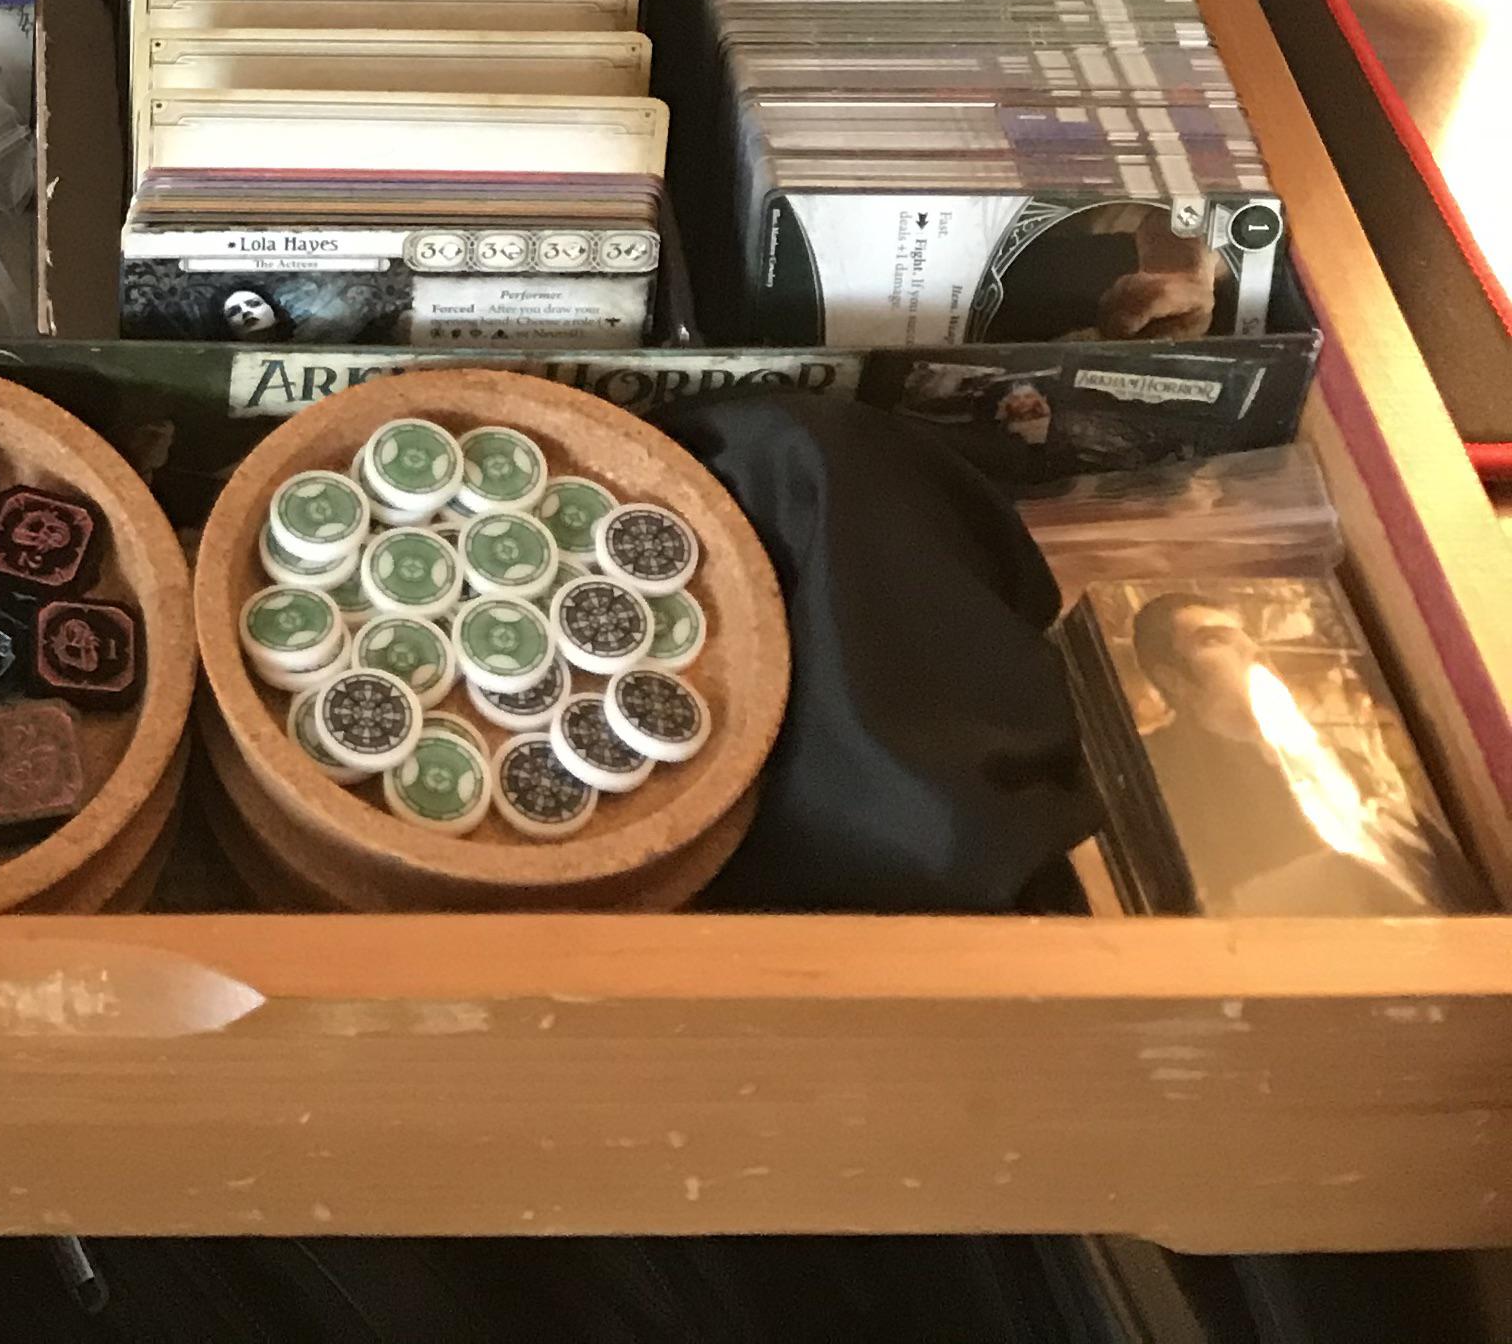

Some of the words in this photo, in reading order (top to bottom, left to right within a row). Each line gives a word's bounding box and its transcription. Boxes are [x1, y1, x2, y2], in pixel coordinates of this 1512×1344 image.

[898, 211, 912, 241] deals
[938, 211, 952, 238] Fast.
[240, 237, 276, 251] Lola
[284, 237, 338, 255] Hayes
[420, 243, 436, 259] 3
[481, 243, 497, 259] 3
[544, 243, 560, 260] 3
[606, 243, 622, 260] 3
[910, 239, 928, 275] Fight.
[432, 304, 475, 314] Forced
